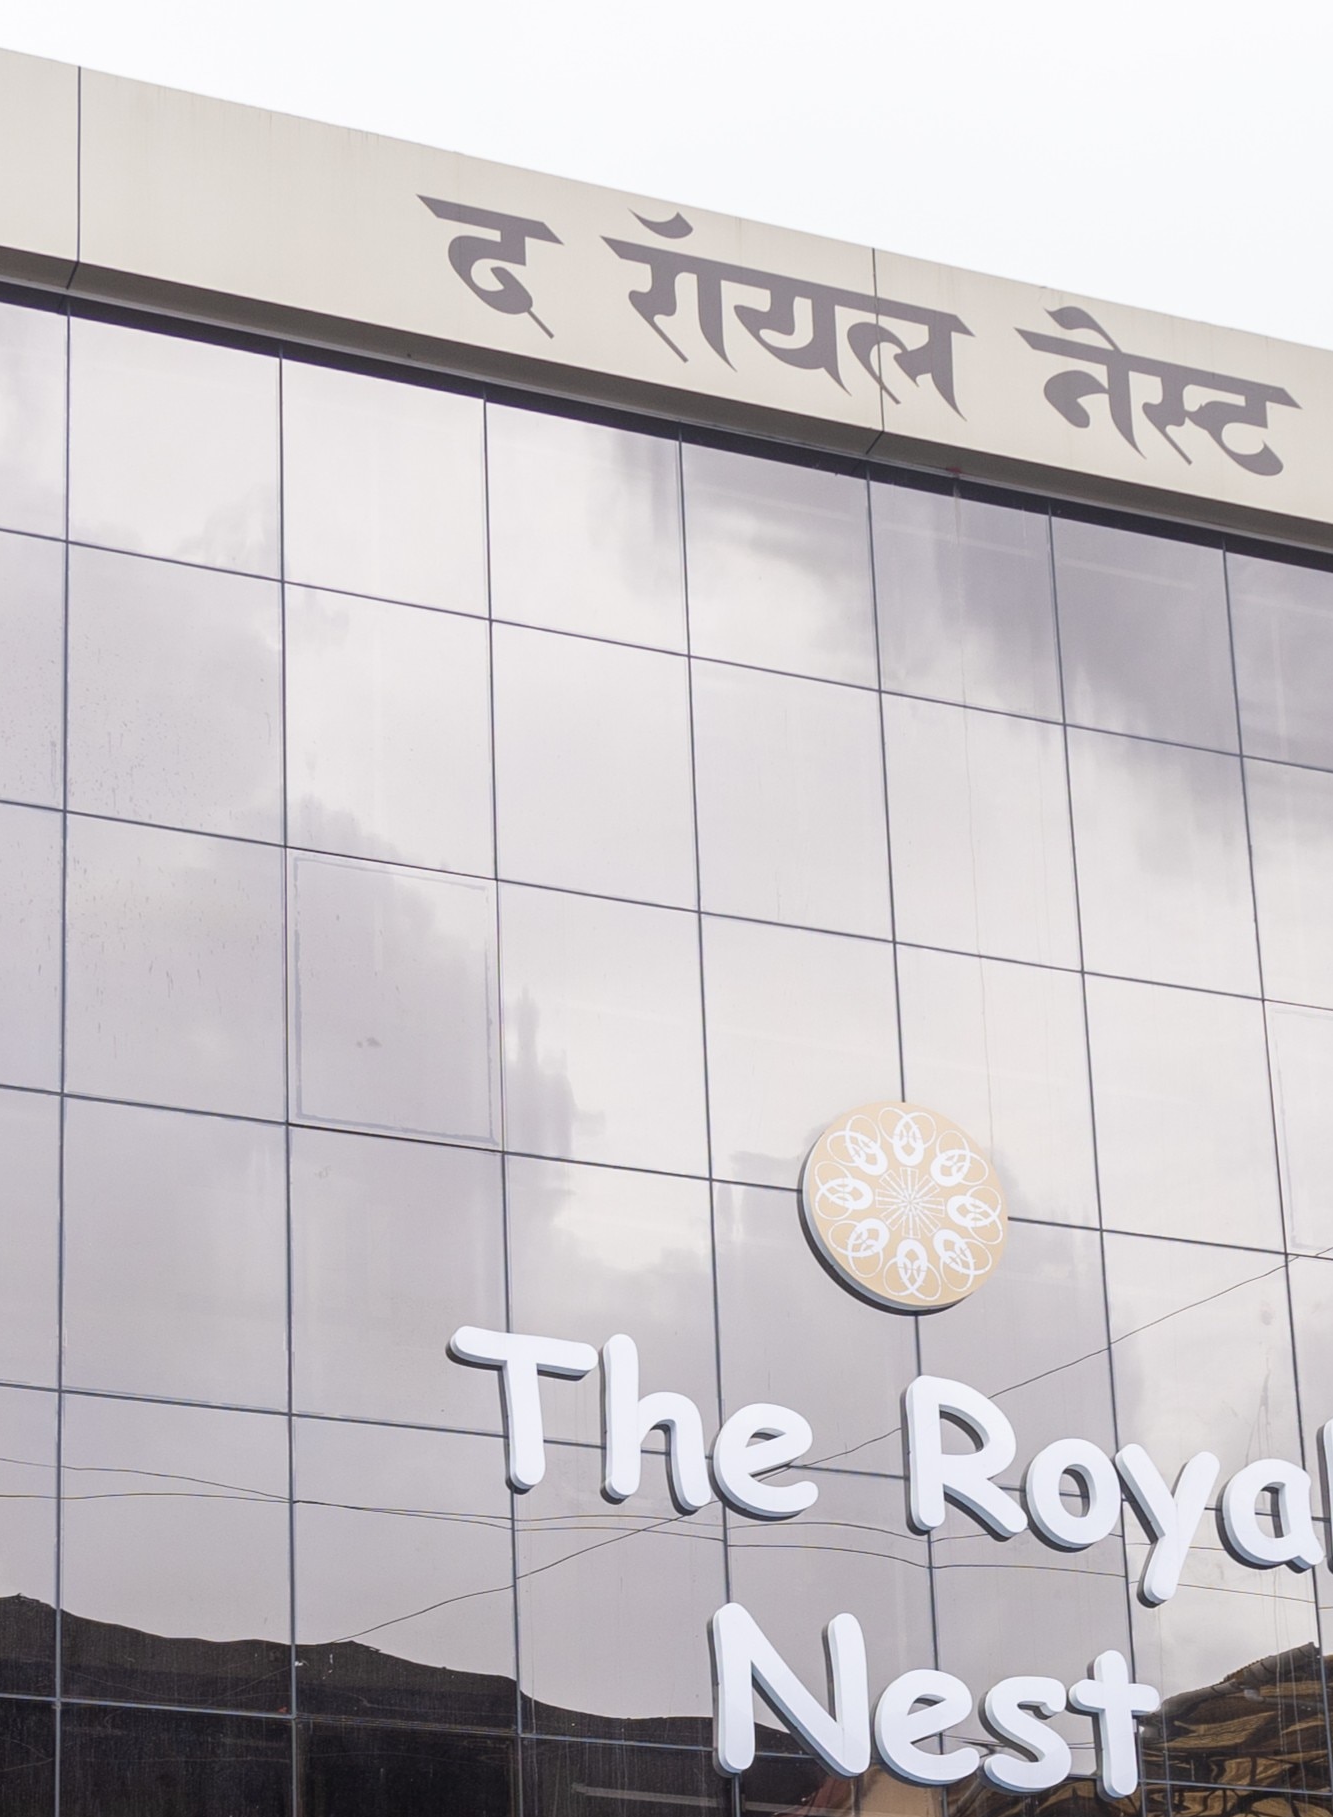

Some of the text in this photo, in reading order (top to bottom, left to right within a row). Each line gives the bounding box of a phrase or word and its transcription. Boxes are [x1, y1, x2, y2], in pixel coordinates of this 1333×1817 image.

[416, 194, 1303, 477] द रॉयल नेस्ट
[448, 1325, 820, 1519] The
[711, 1601, 1161, 1798] Nest
